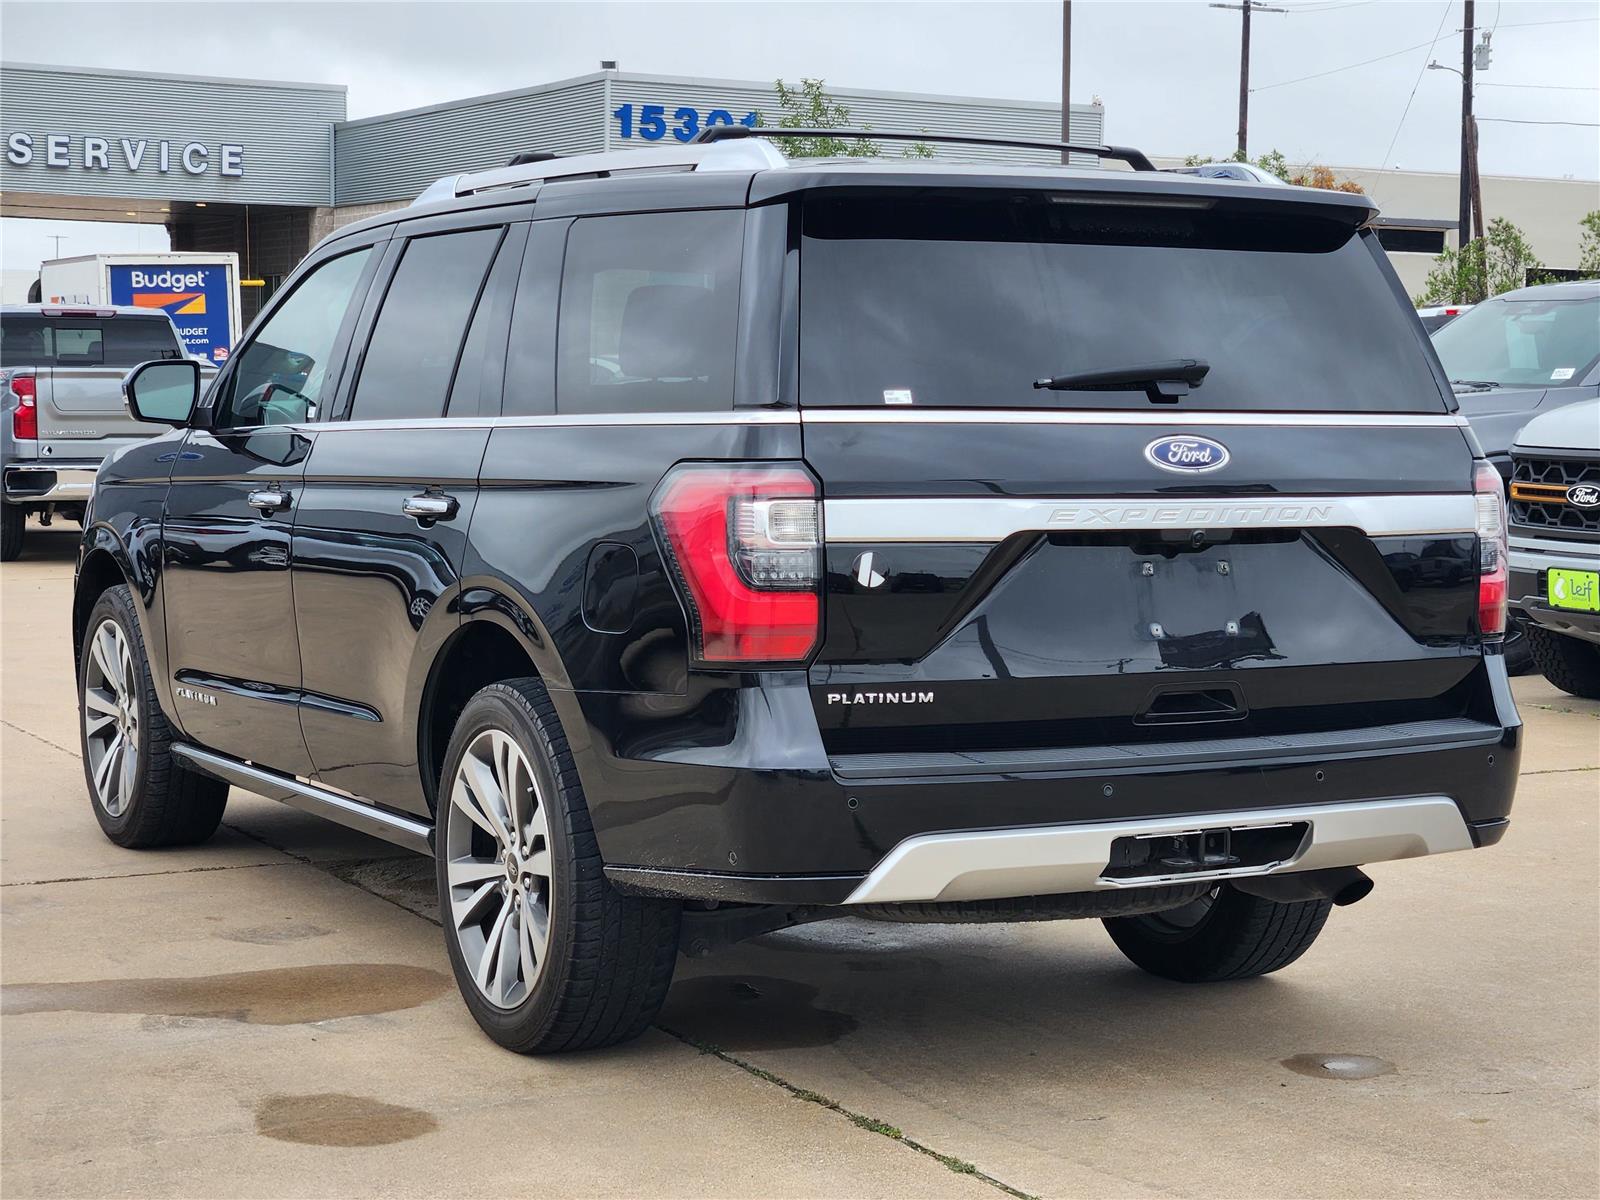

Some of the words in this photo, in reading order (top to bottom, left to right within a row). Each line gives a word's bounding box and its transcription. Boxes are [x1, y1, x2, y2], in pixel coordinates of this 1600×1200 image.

[7, 132, 244, 177] SERVICE
[131, 271, 205, 292] Budget
[1168, 442, 1212, 463] Ford
[1573, 487, 1599, 503] Ford
[1047, 505, 1335, 525] EXPEDITION
[827, 691, 935, 705] PLATINUM
